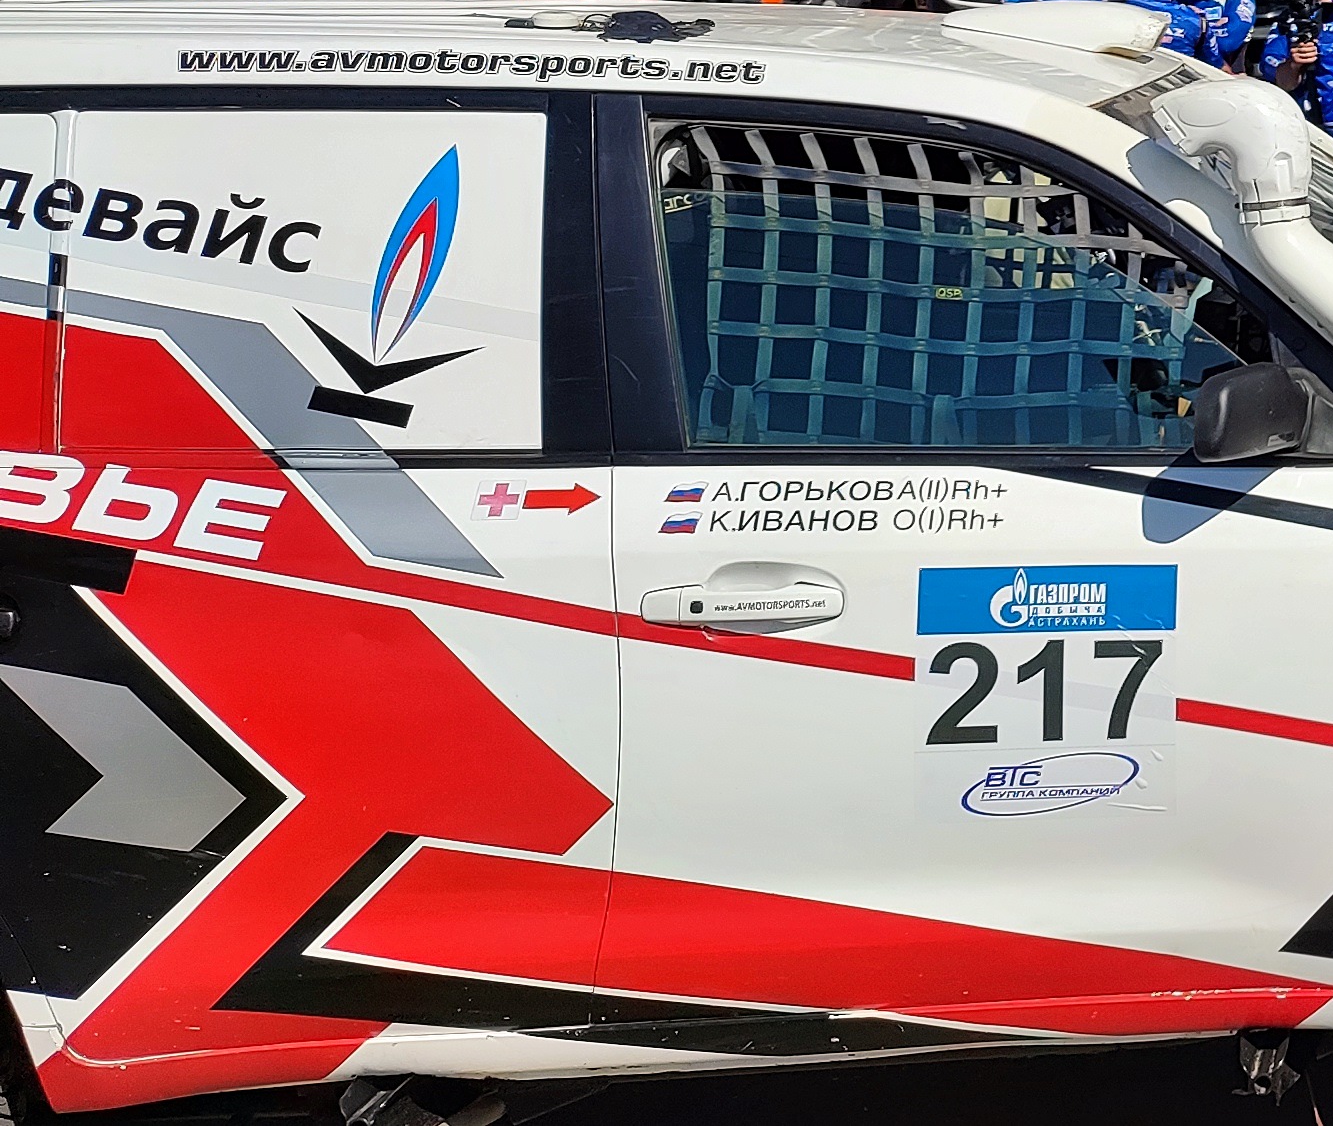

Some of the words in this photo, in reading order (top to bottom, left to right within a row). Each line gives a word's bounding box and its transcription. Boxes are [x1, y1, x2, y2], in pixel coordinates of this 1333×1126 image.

[178, 48, 767, 84] www.avmotorsports.net
[709, 509, 878, 533] К.ИВАНОВ
[1029, 583, 1106, 604] ГАЗПРОМ
[1030, 605, 1105, 616] ДОБЫЧА
[1028, 616, 1106, 628] АСТРАХАНЬ
[926, 639, 1163, 745] 217
[984, 765, 1043, 788] ВТС
[981, 790, 1035, 800] ГРУППА
[1038, 787, 1121, 798] КОМПАНИЙ
